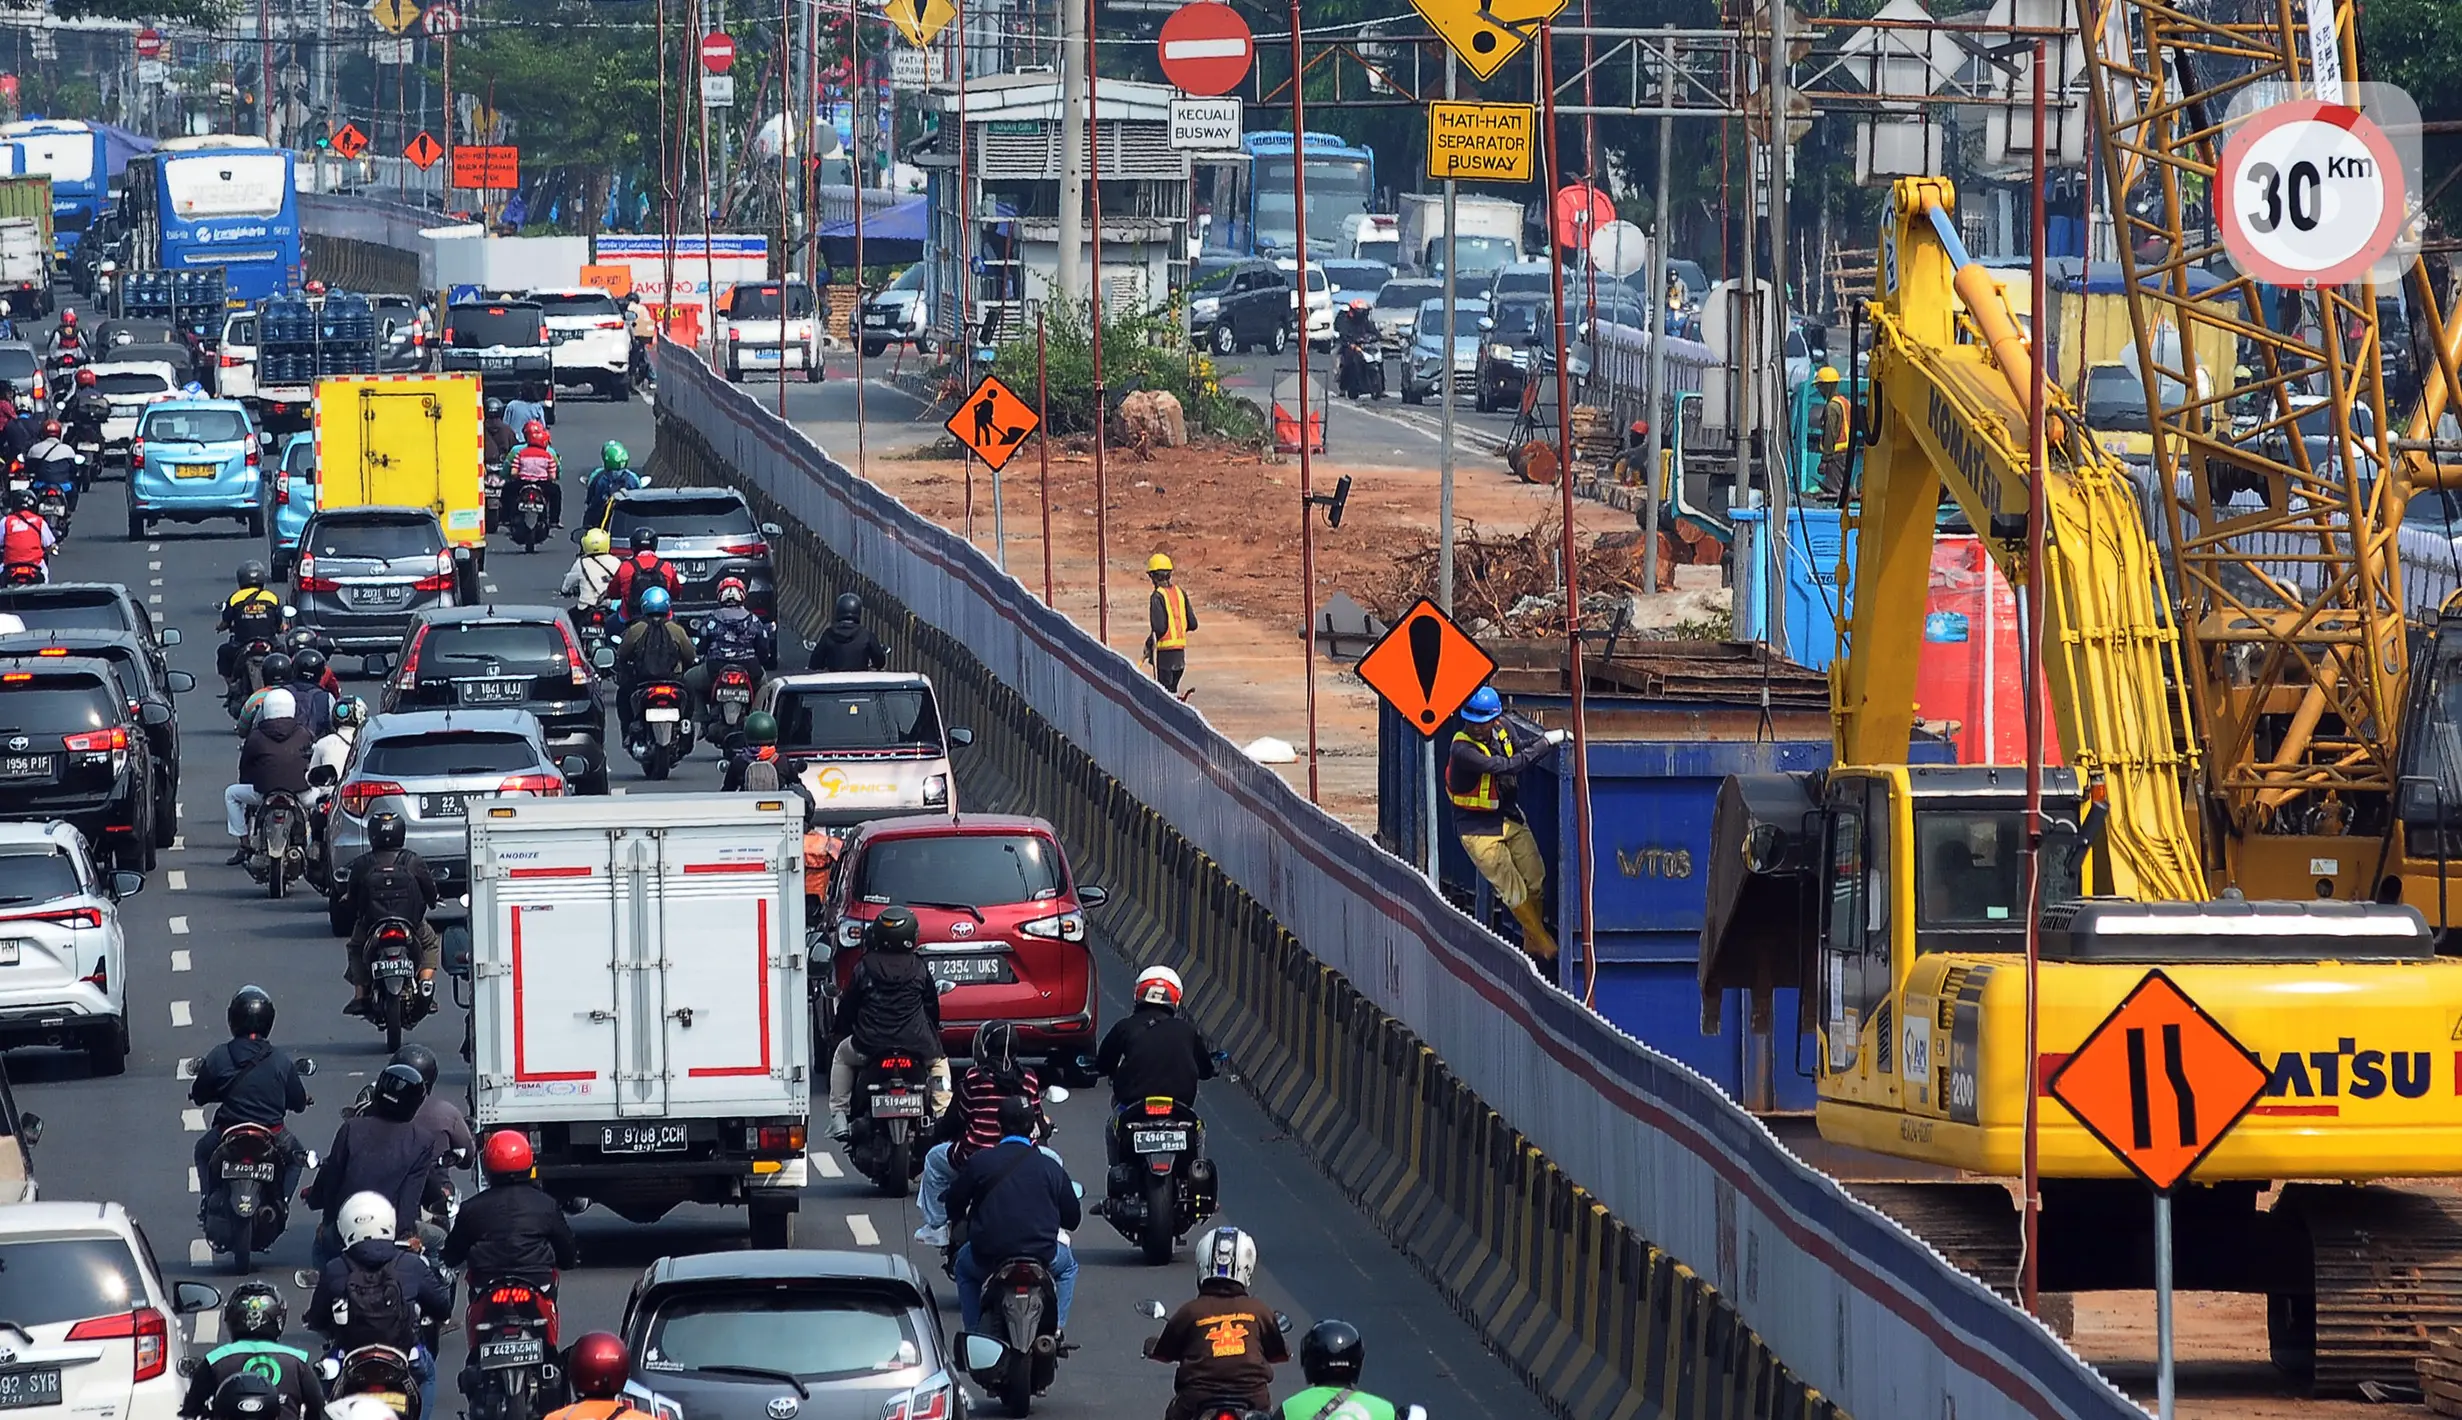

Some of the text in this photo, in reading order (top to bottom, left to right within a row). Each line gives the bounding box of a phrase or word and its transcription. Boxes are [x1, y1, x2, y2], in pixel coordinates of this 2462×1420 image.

[1177, 108, 1235, 121] KECUALI
[1441, 112, 1522, 130] HATI-HATI
[1175, 127, 1233, 140] BUSWAY
[1438, 133, 1526, 151] SEPARATOR
[1448, 155, 1518, 171] BUSWAY
[2246, 156, 2373, 234] 30 Km
[353, 588, 359, 598] B
[466, 683, 473, 695] B
[6, 757, 29, 770] 1956
[421, 796, 429, 810] B
[498, 851, 540, 860] ANODIZE
[942, 958, 970, 974] 2354
[977, 959, 999, 974] UKS
[2250, 1037, 2432, 1099] ATSU
[1951, 1071, 1975, 1108] 200
[604, 1128, 613, 1145] B
[661, 1126, 685, 1142] CCH
[29, 1373, 57, 1393] SYR
